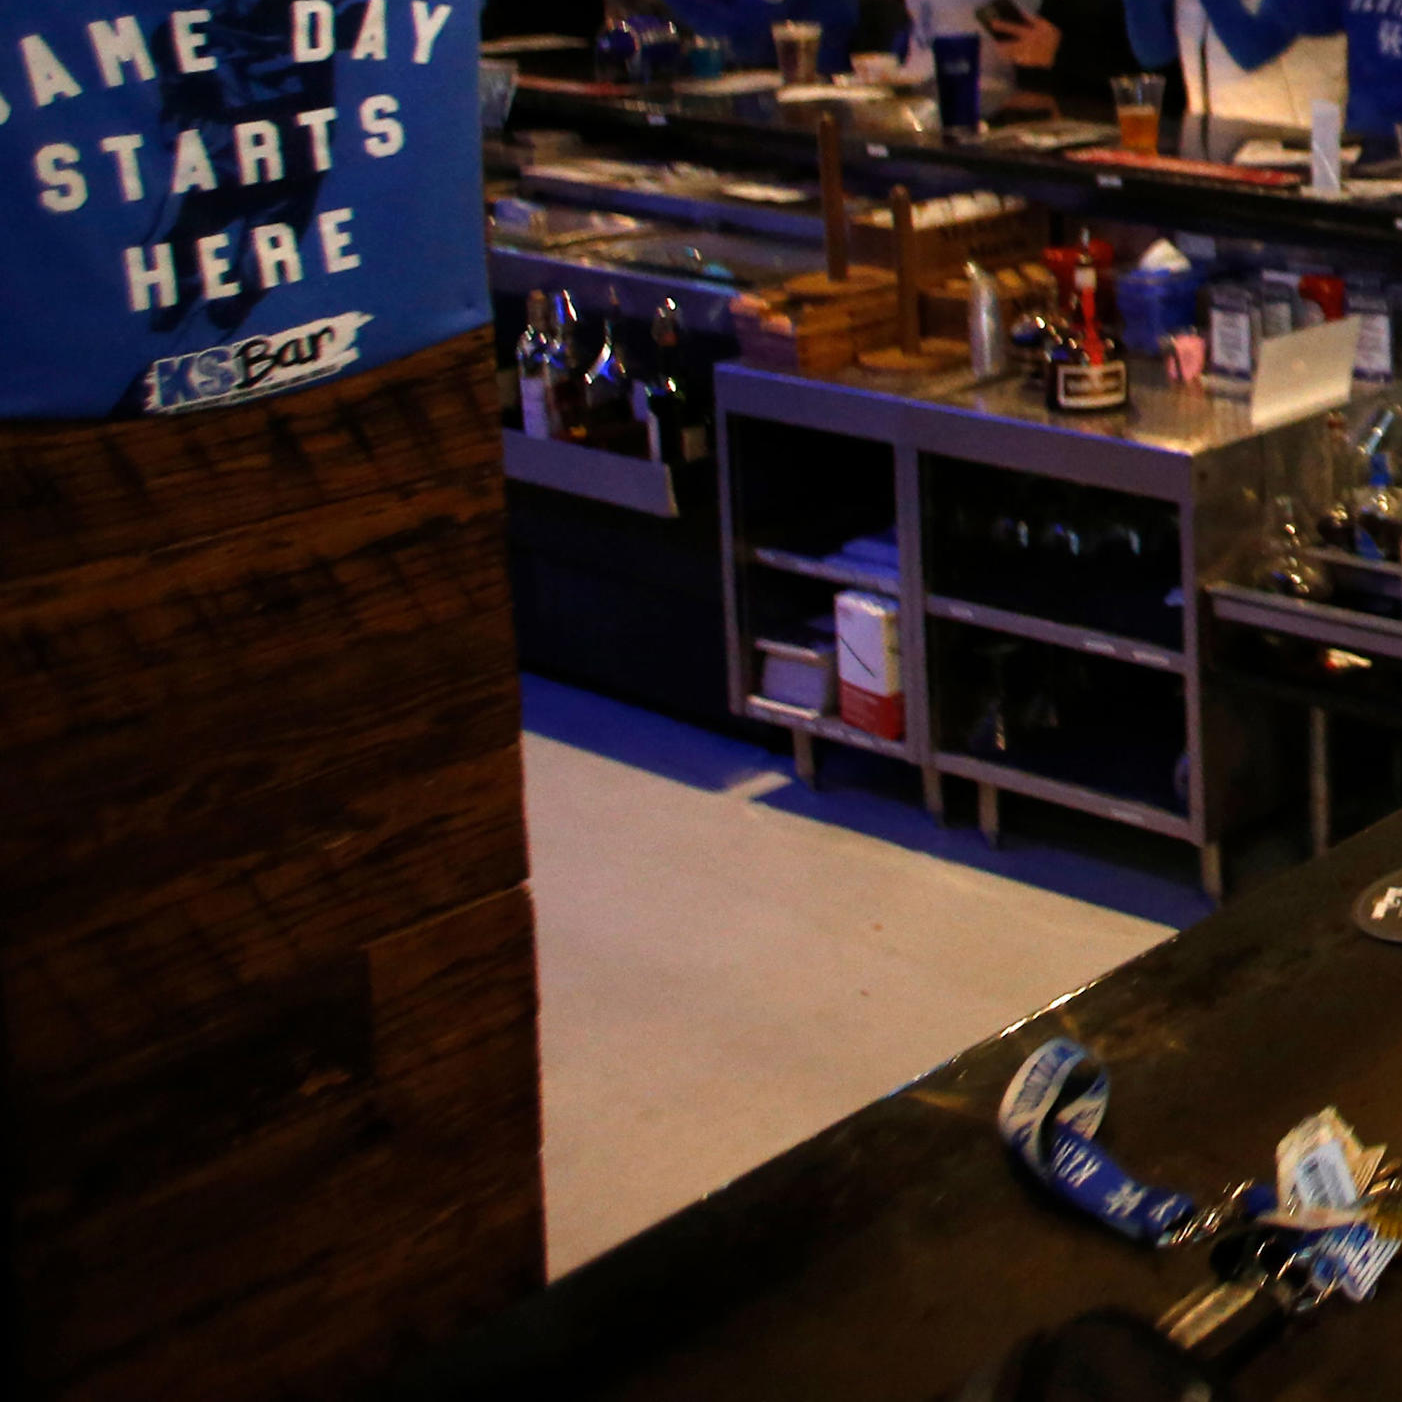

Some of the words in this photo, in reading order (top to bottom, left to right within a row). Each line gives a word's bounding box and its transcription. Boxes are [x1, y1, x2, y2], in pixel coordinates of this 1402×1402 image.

[0, 8, 218, 125] AME
[34, 94, 405, 214] STARTS
[124, 207, 361, 312] HERE
